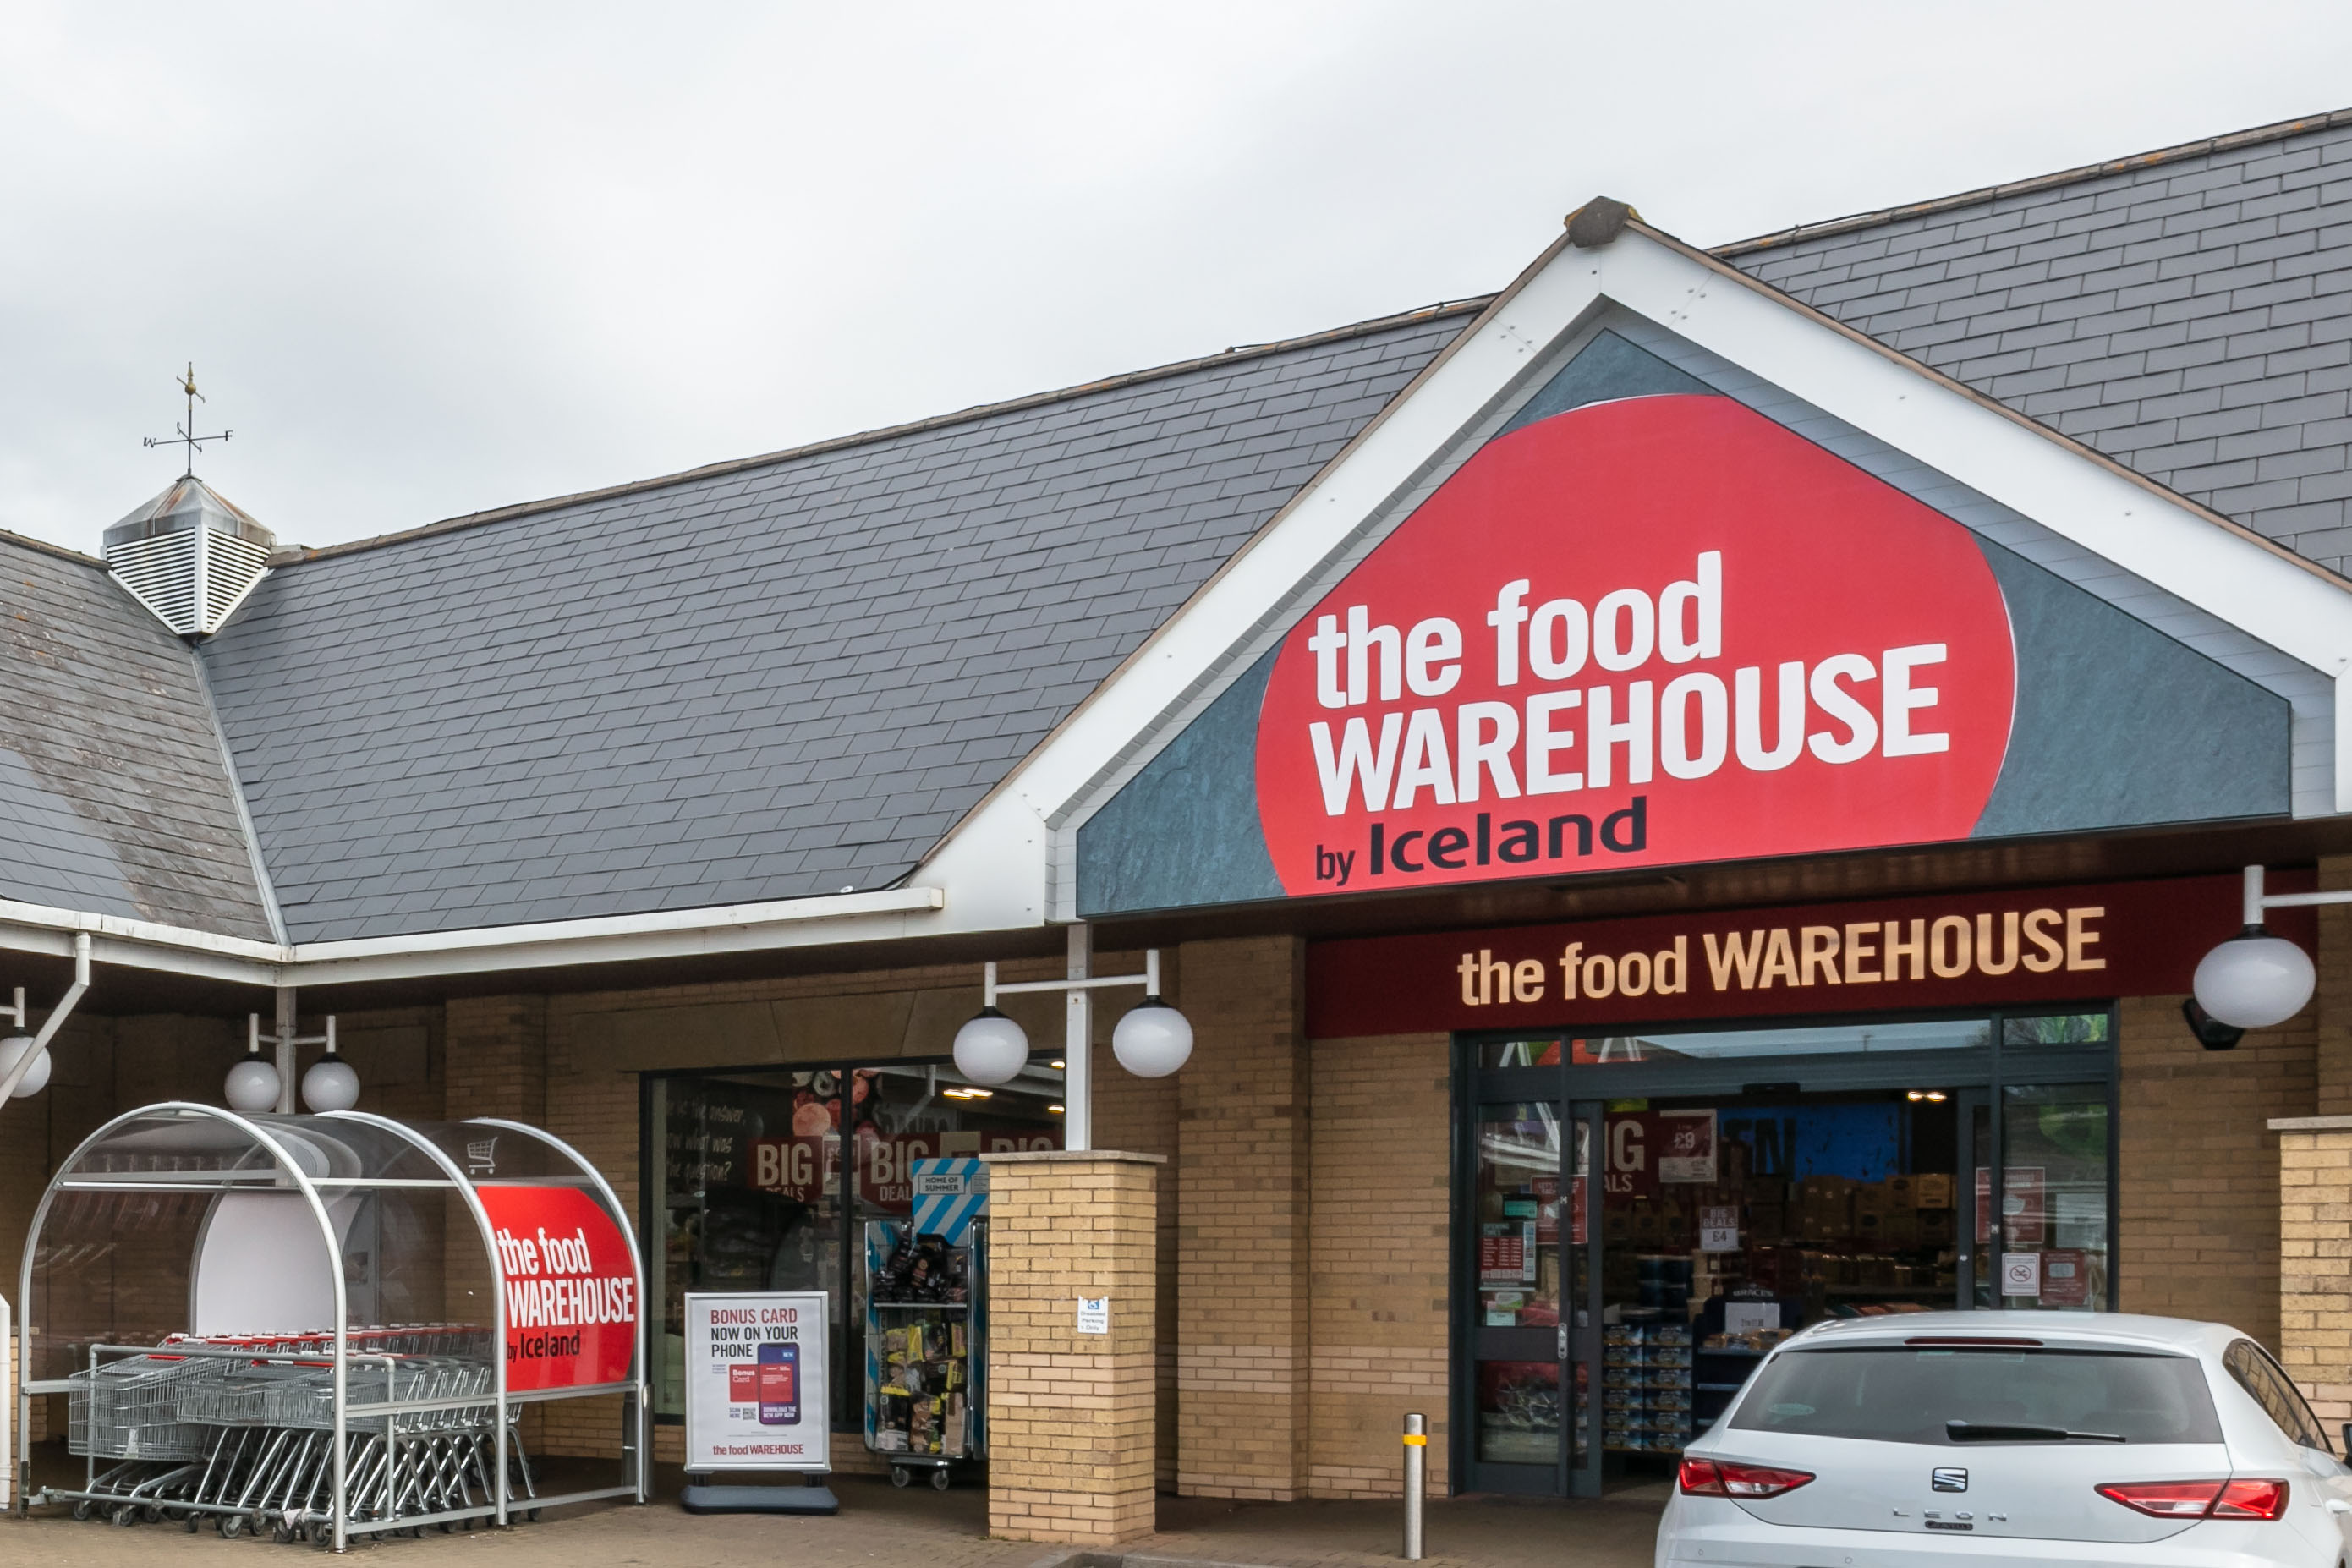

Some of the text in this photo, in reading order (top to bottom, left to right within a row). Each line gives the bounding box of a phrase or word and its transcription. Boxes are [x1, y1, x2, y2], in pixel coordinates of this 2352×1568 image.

[1308, 550, 1722, 709] the food
[1309, 643, 1950, 816] WAREHOUSE
[1316, 796, 1647, 886] by Iceland
[1456, 907, 2106, 1006] the food WAREHOUSE
[757, 1143, 813, 1187] BIG
[880, 1185, 913, 1202] DEAL
[496, 1226, 593, 1276] the food
[506, 1277, 635, 1329] WAREHOUSE
[711, 1308, 798, 1324] BONUS CARD
[520, 1330, 581, 1359] Iceland
[711, 1326, 798, 1340] NOW ON YOUR
[711, 1343, 754, 1357] PHONE
[713, 1444, 804, 1455] the food WAREHOUSE
[1893, 1506, 2008, 1521] LEON
